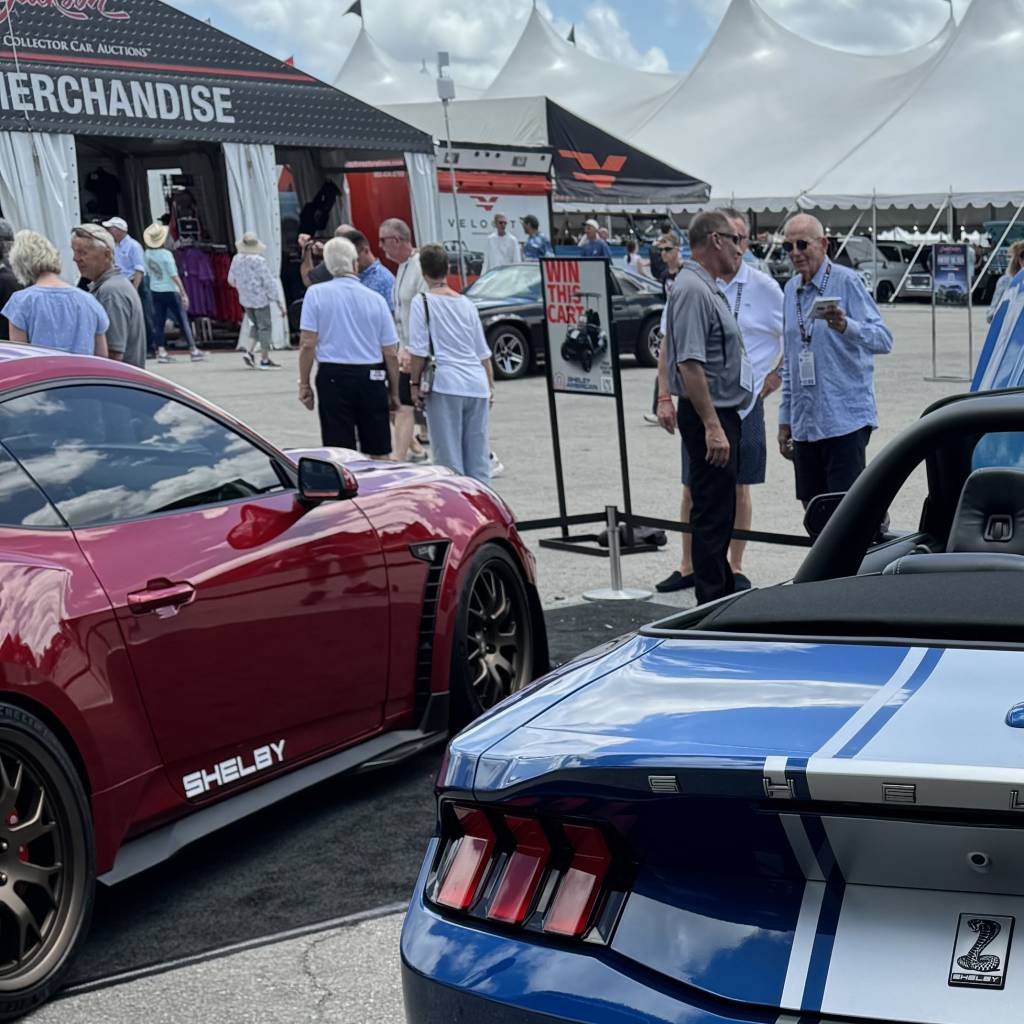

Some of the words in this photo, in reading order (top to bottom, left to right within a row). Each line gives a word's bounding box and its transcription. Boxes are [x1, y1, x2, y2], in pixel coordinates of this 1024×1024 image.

[3, 35, 68, 51] COLLECTOR
[70, 40, 94, 53] CAR
[545, 259, 580, 283] WIN
[546, 284, 582, 304] THIS
[182, 739, 286, 798] SHELBY
[952, 973, 1001, 984] SHELBY
